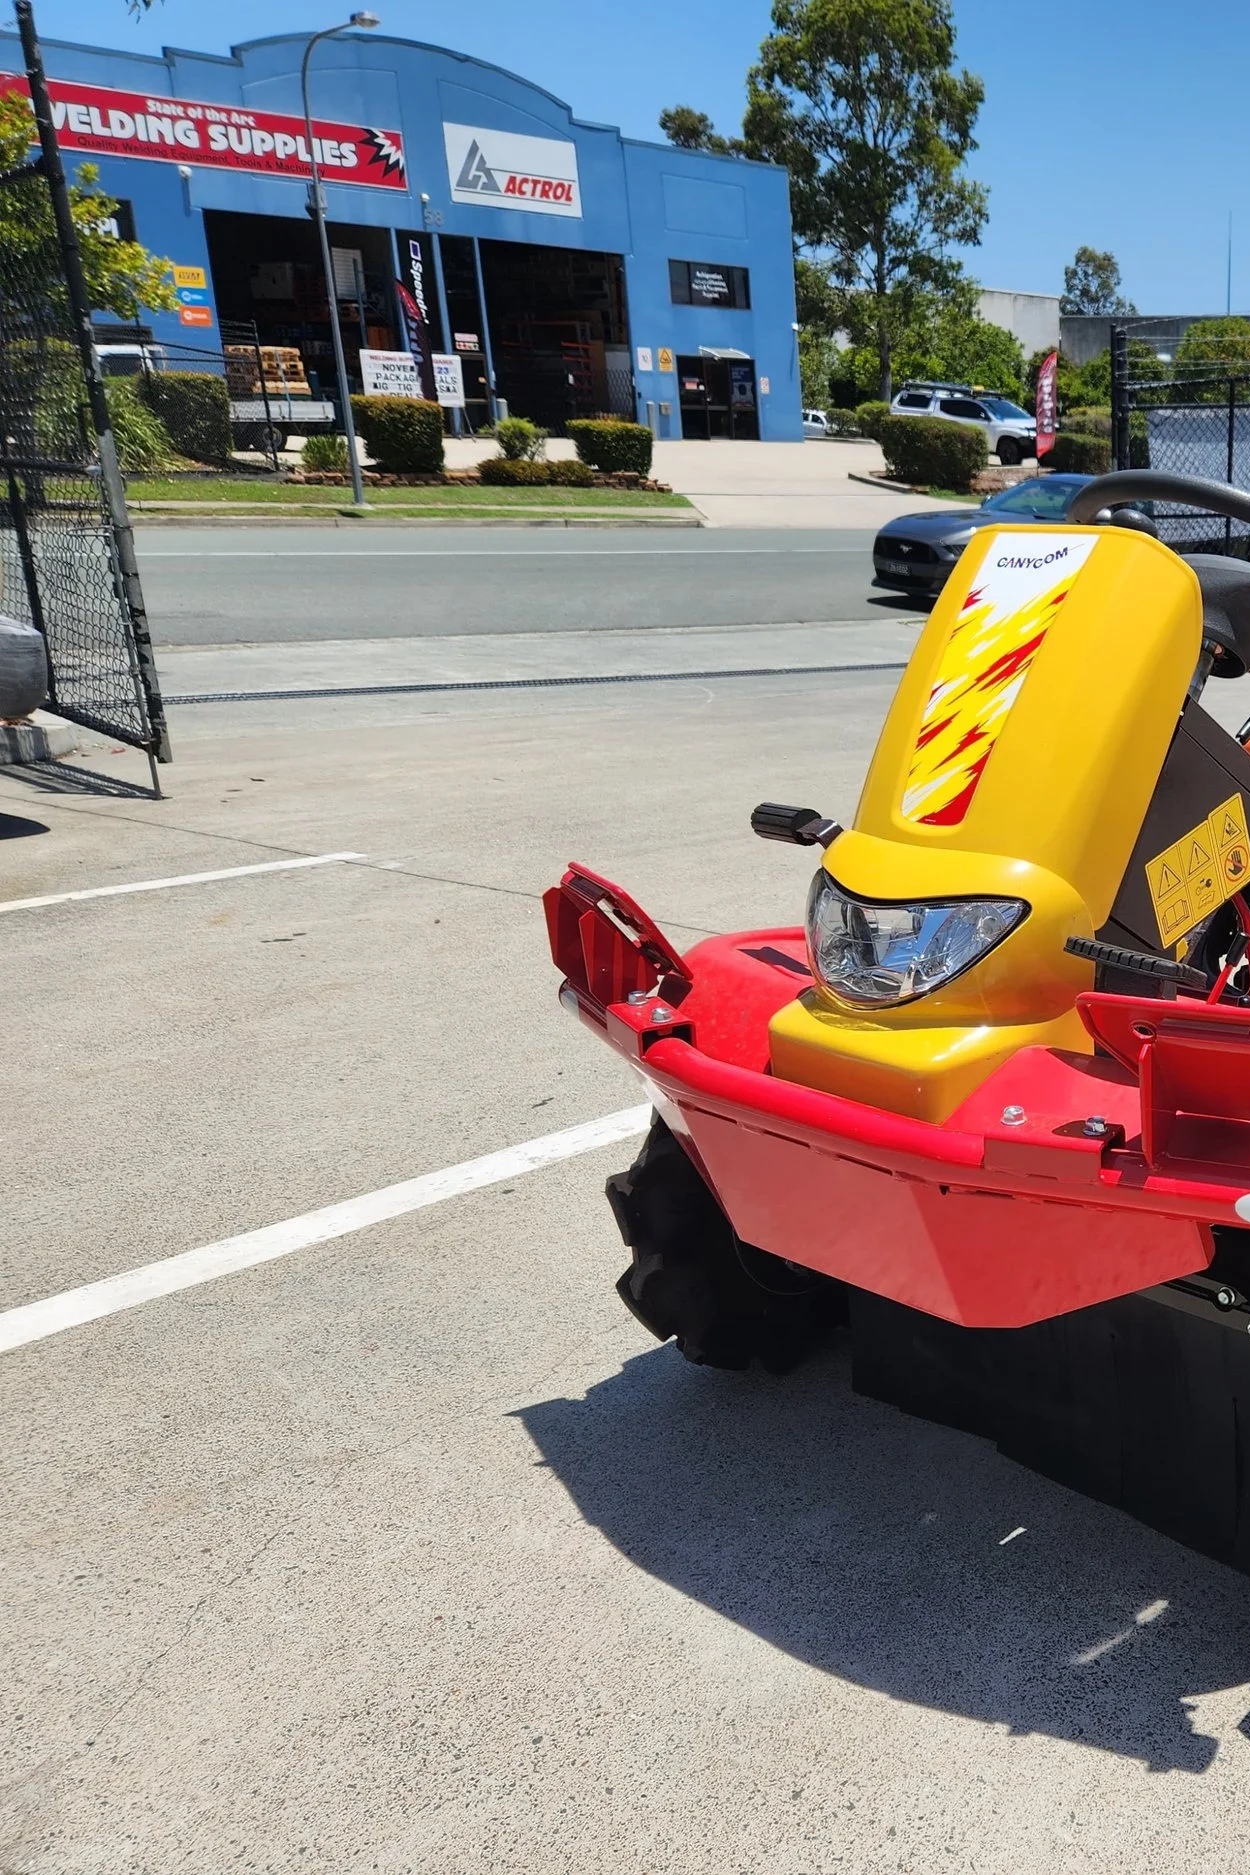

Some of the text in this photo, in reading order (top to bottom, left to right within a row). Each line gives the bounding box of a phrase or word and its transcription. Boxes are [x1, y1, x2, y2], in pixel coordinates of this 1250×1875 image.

[146, 100, 256, 127] State of the Arc
[28, 98, 358, 168] WELDING SUPPLIES
[77, 136, 119, 151] Quality
[123, 142, 171, 158] Welding
[235, 156, 262, 169] Tools
[265, 160, 272, 169] &
[275, 161, 326, 178] Machinry
[504, 175, 573, 202] ACTROL
[424, 208, 444, 226] 58
[436, 366, 449, 375] 23
[397, 383, 413, 391] TIG
[996, 546, 1069, 569] CANYCOM
